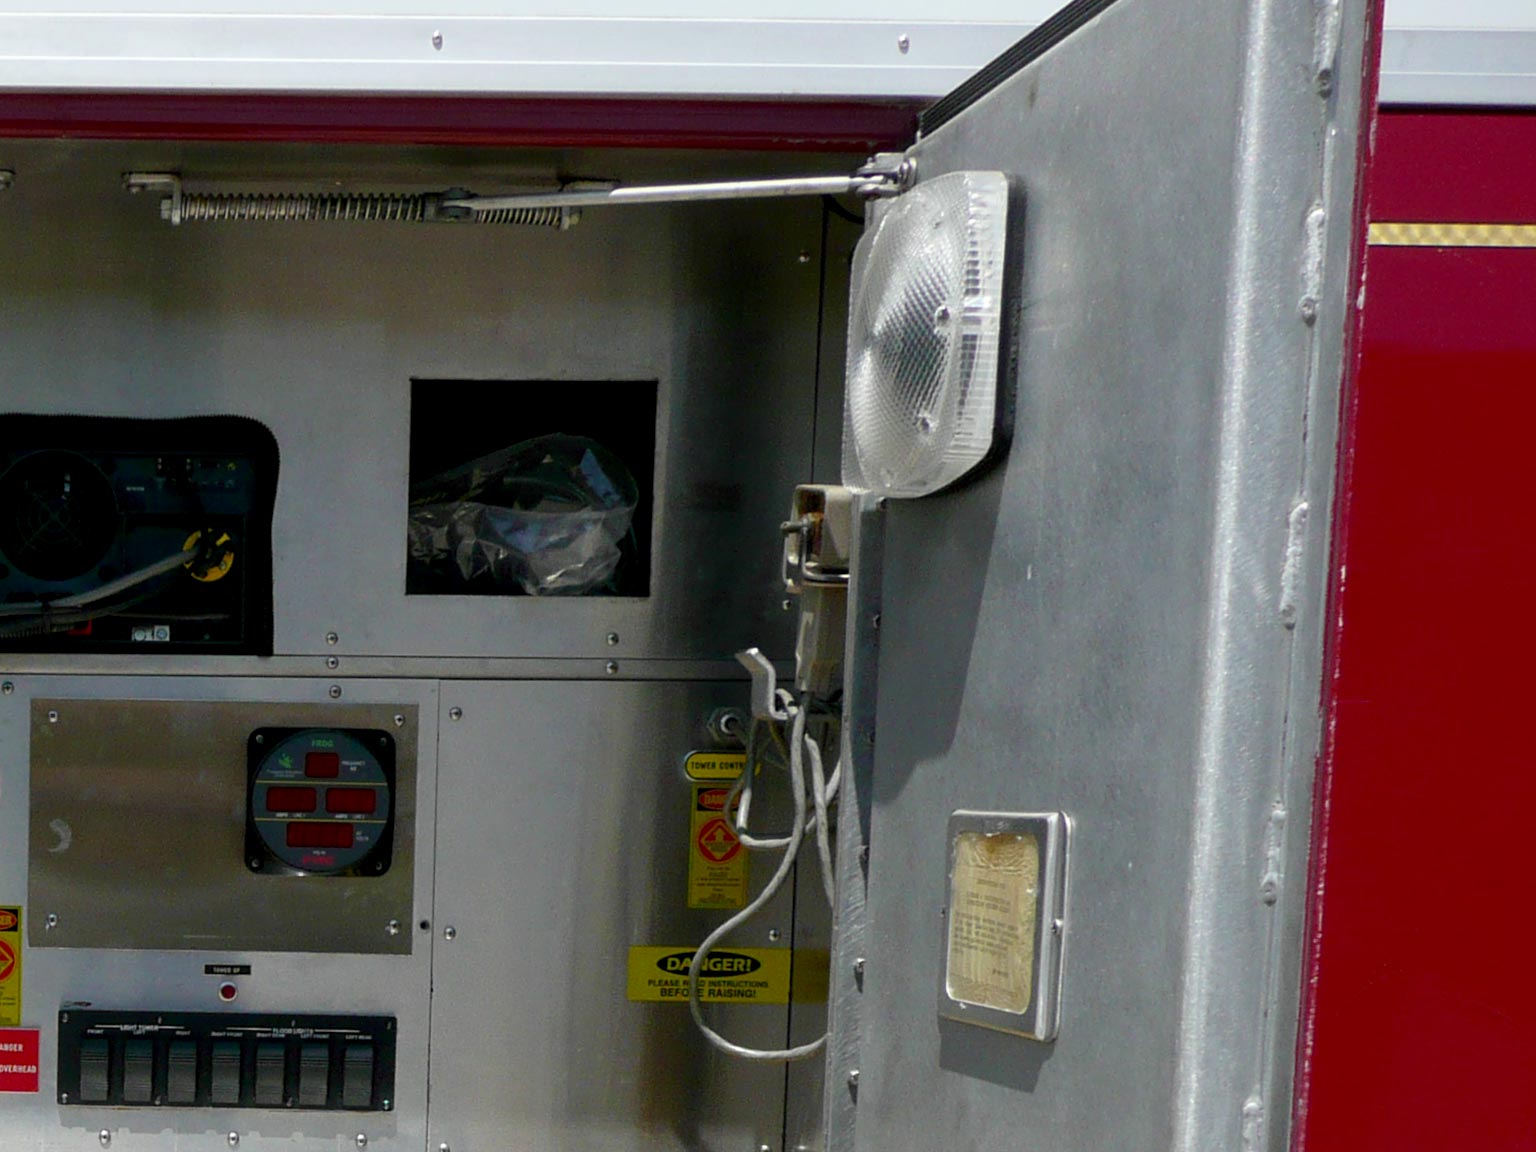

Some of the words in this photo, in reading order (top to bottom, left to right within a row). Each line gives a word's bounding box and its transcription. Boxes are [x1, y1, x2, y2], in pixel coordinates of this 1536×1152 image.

[691, 761, 716, 770] TOWER
[719, 761, 745, 770] CONTR
[648, 979, 679, 987] PLEASE
[683, 979, 706, 987] RD
[708, 980, 768, 988] INSTRUCTIONS
[660, 988, 705, 997] BEFOE
[708, 988, 757, 998] RAISING!
